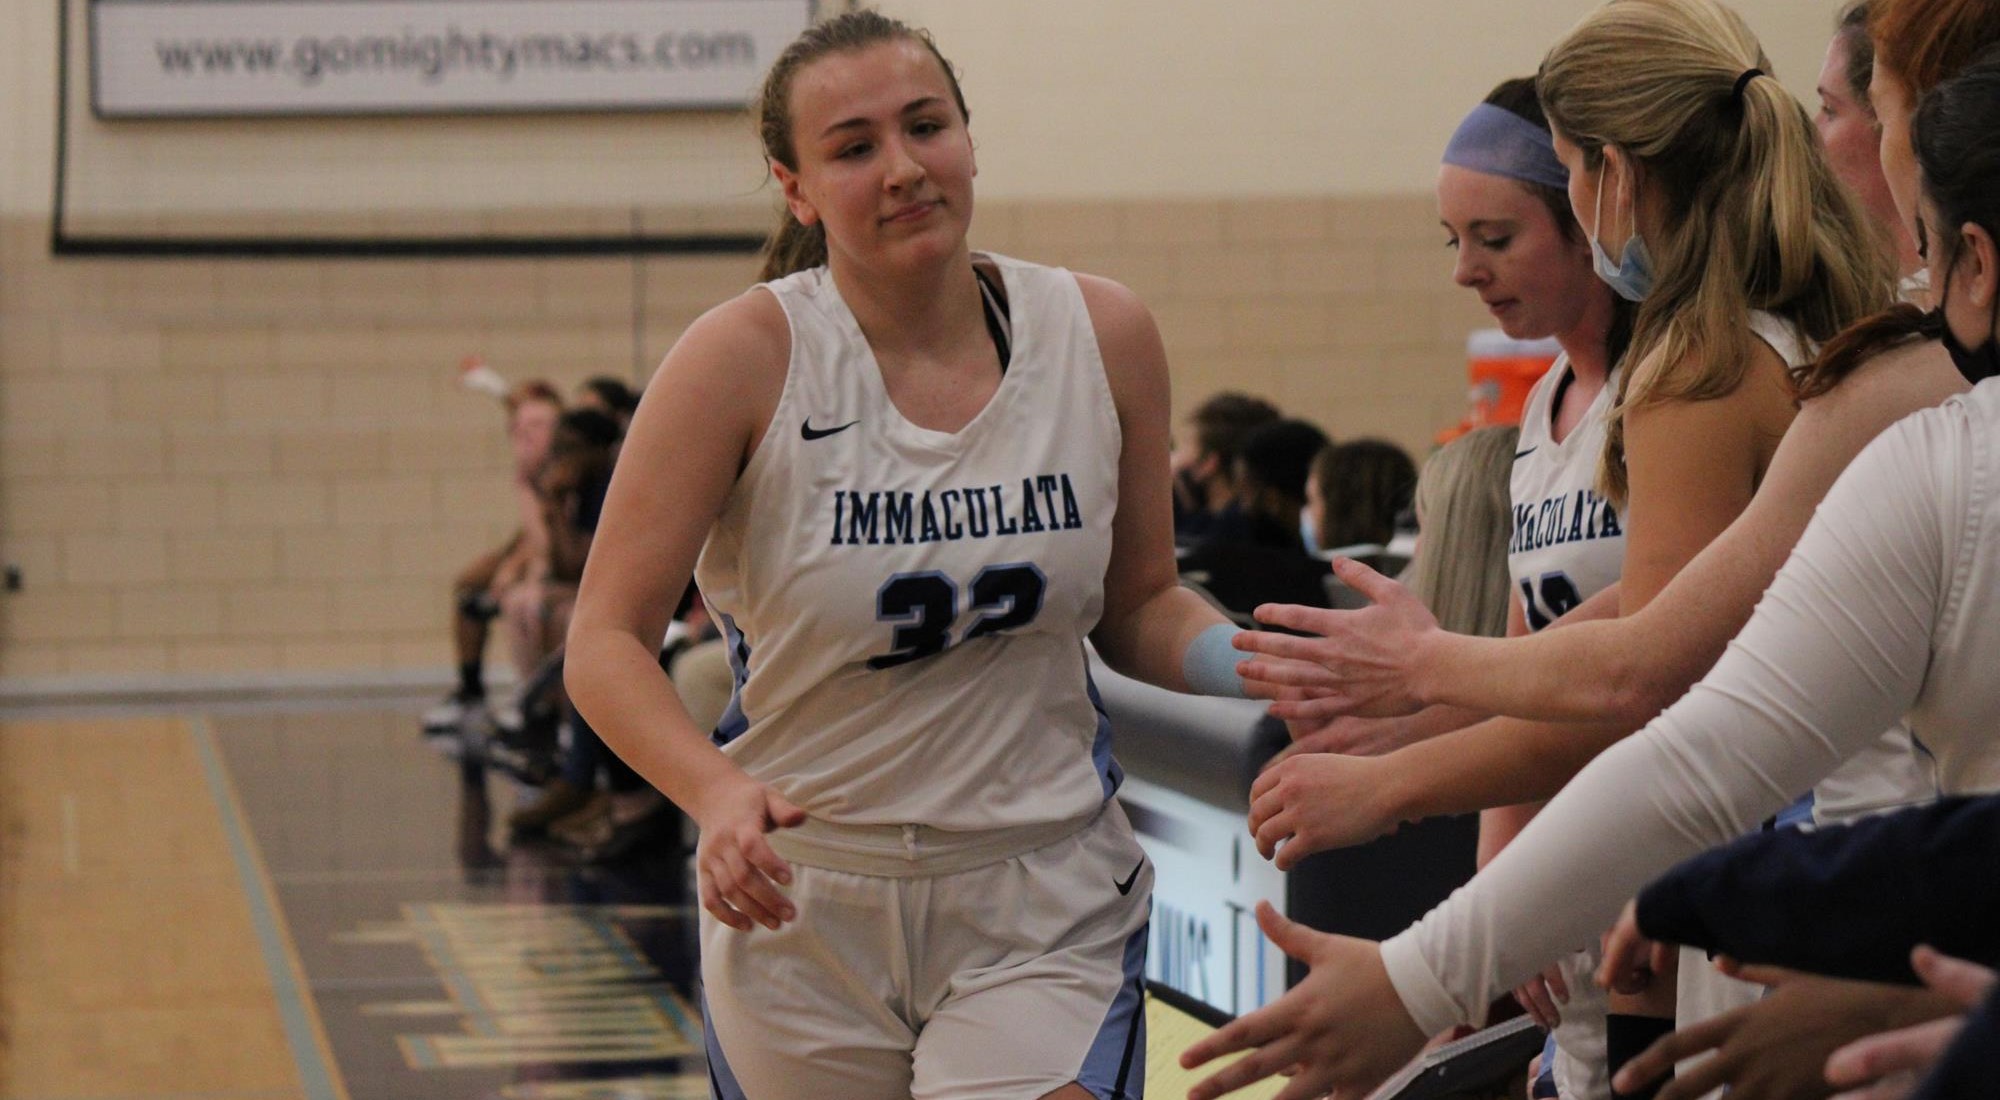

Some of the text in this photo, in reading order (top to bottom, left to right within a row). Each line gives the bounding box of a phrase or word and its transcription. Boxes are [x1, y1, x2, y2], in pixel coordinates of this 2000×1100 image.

[155, 24, 757, 85] www.gomightymacs.com
[830, 473, 1083, 546] IMMACULATA
[866, 561, 1048, 672] 32
